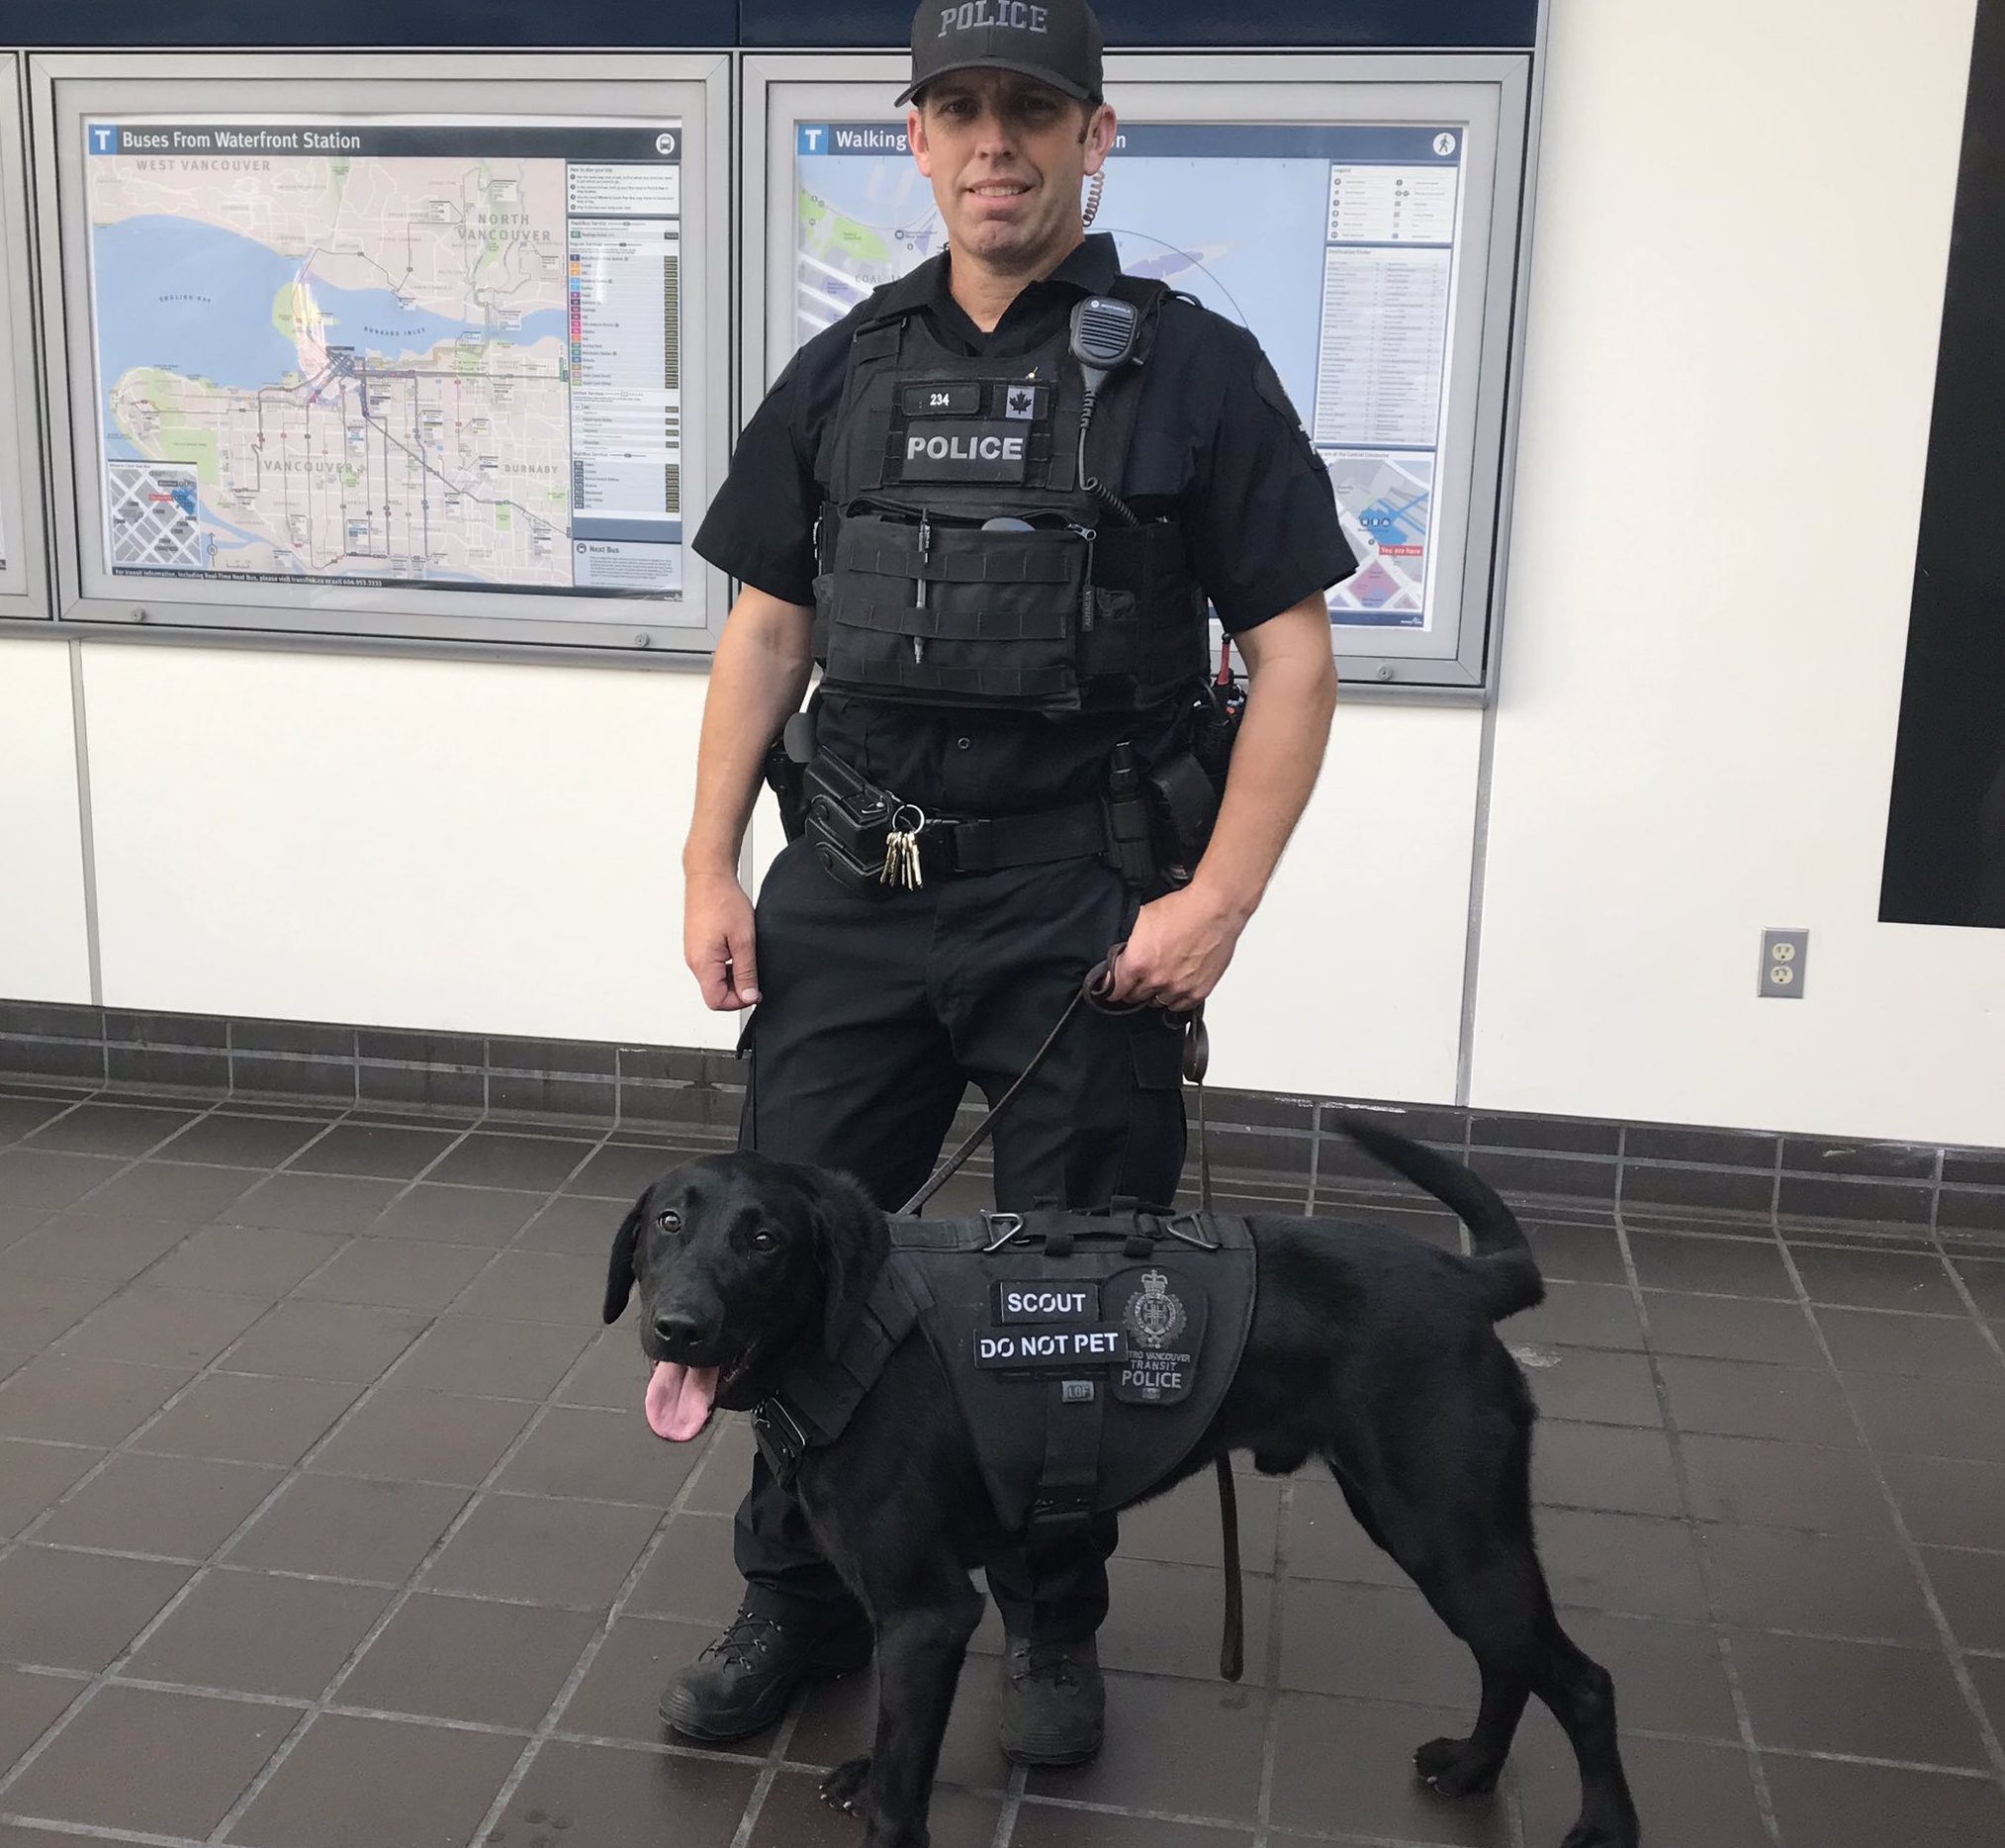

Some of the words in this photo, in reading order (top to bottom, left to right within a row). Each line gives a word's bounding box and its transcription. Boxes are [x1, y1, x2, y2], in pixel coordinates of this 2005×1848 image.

[938, 0, 1048, 38] POLICE
[123, 131, 169, 148] Buses
[173, 131, 211, 148] From
[215, 131, 299, 148] Waterfront
[303, 132, 361, 149] Station
[836, 130, 908, 151] Walking
[137, 159, 175, 171] WEST
[181, 159, 270, 171] VANCOUVER
[478, 213, 529, 226] NORTH
[457, 229, 551, 241] VANCOUVER
[855, 274, 883, 283] COAL
[929, 393, 951, 407] 234
[906, 435, 1024, 460] POLICE
[263, 460, 353, 473] VANCOUVER
[504, 464, 558, 474] BURNABY
[1007, 1292, 1086, 1313] SCOUT
[980, 1338, 1014, 1358] DO
[1021, 1335, 1068, 1356] NOT
[1074, 1332, 1119, 1353] PET
[1128, 1350, 1143, 1359] TRO
[1145, 1351, 1191, 1363] VANCOUVER
[1131, 1359, 1178, 1371] TRANSIT
[1122, 1369, 1182, 1389] POLICE
